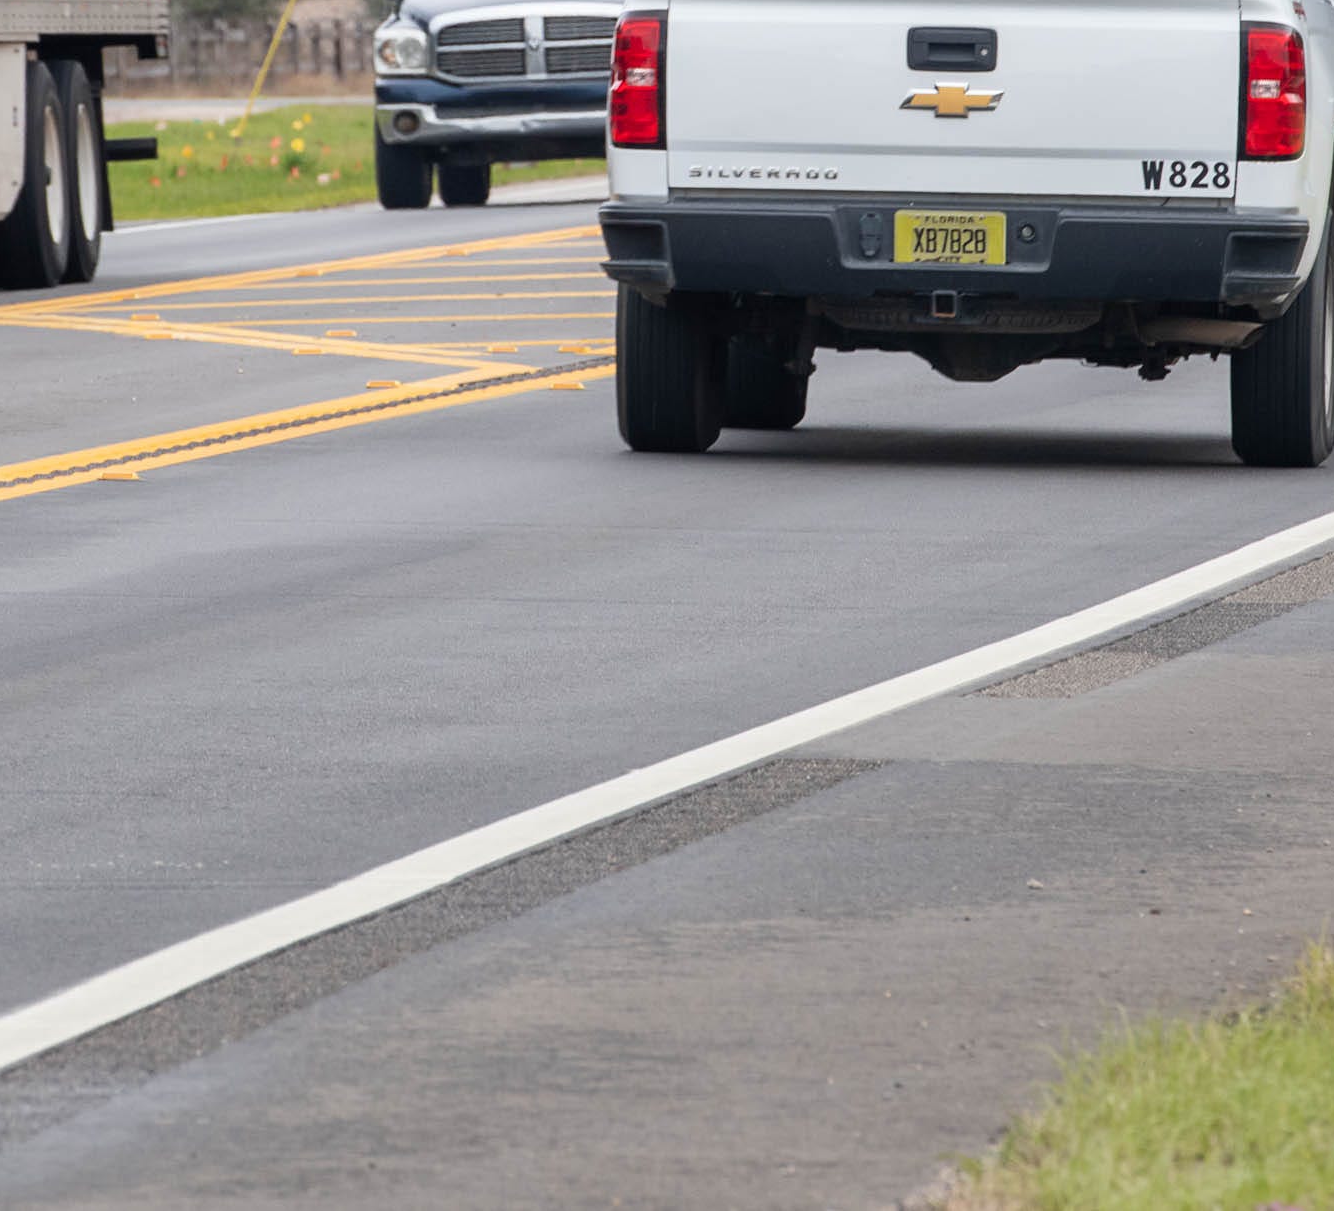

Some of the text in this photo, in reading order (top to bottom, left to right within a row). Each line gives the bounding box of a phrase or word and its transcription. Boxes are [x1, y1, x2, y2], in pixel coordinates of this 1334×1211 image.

[688, 165, 839, 180] SILVERADO
[1142, 160, 1231, 190] W828
[924, 215, 975, 224] FLORIDA
[913, 228, 986, 254] XB7828
